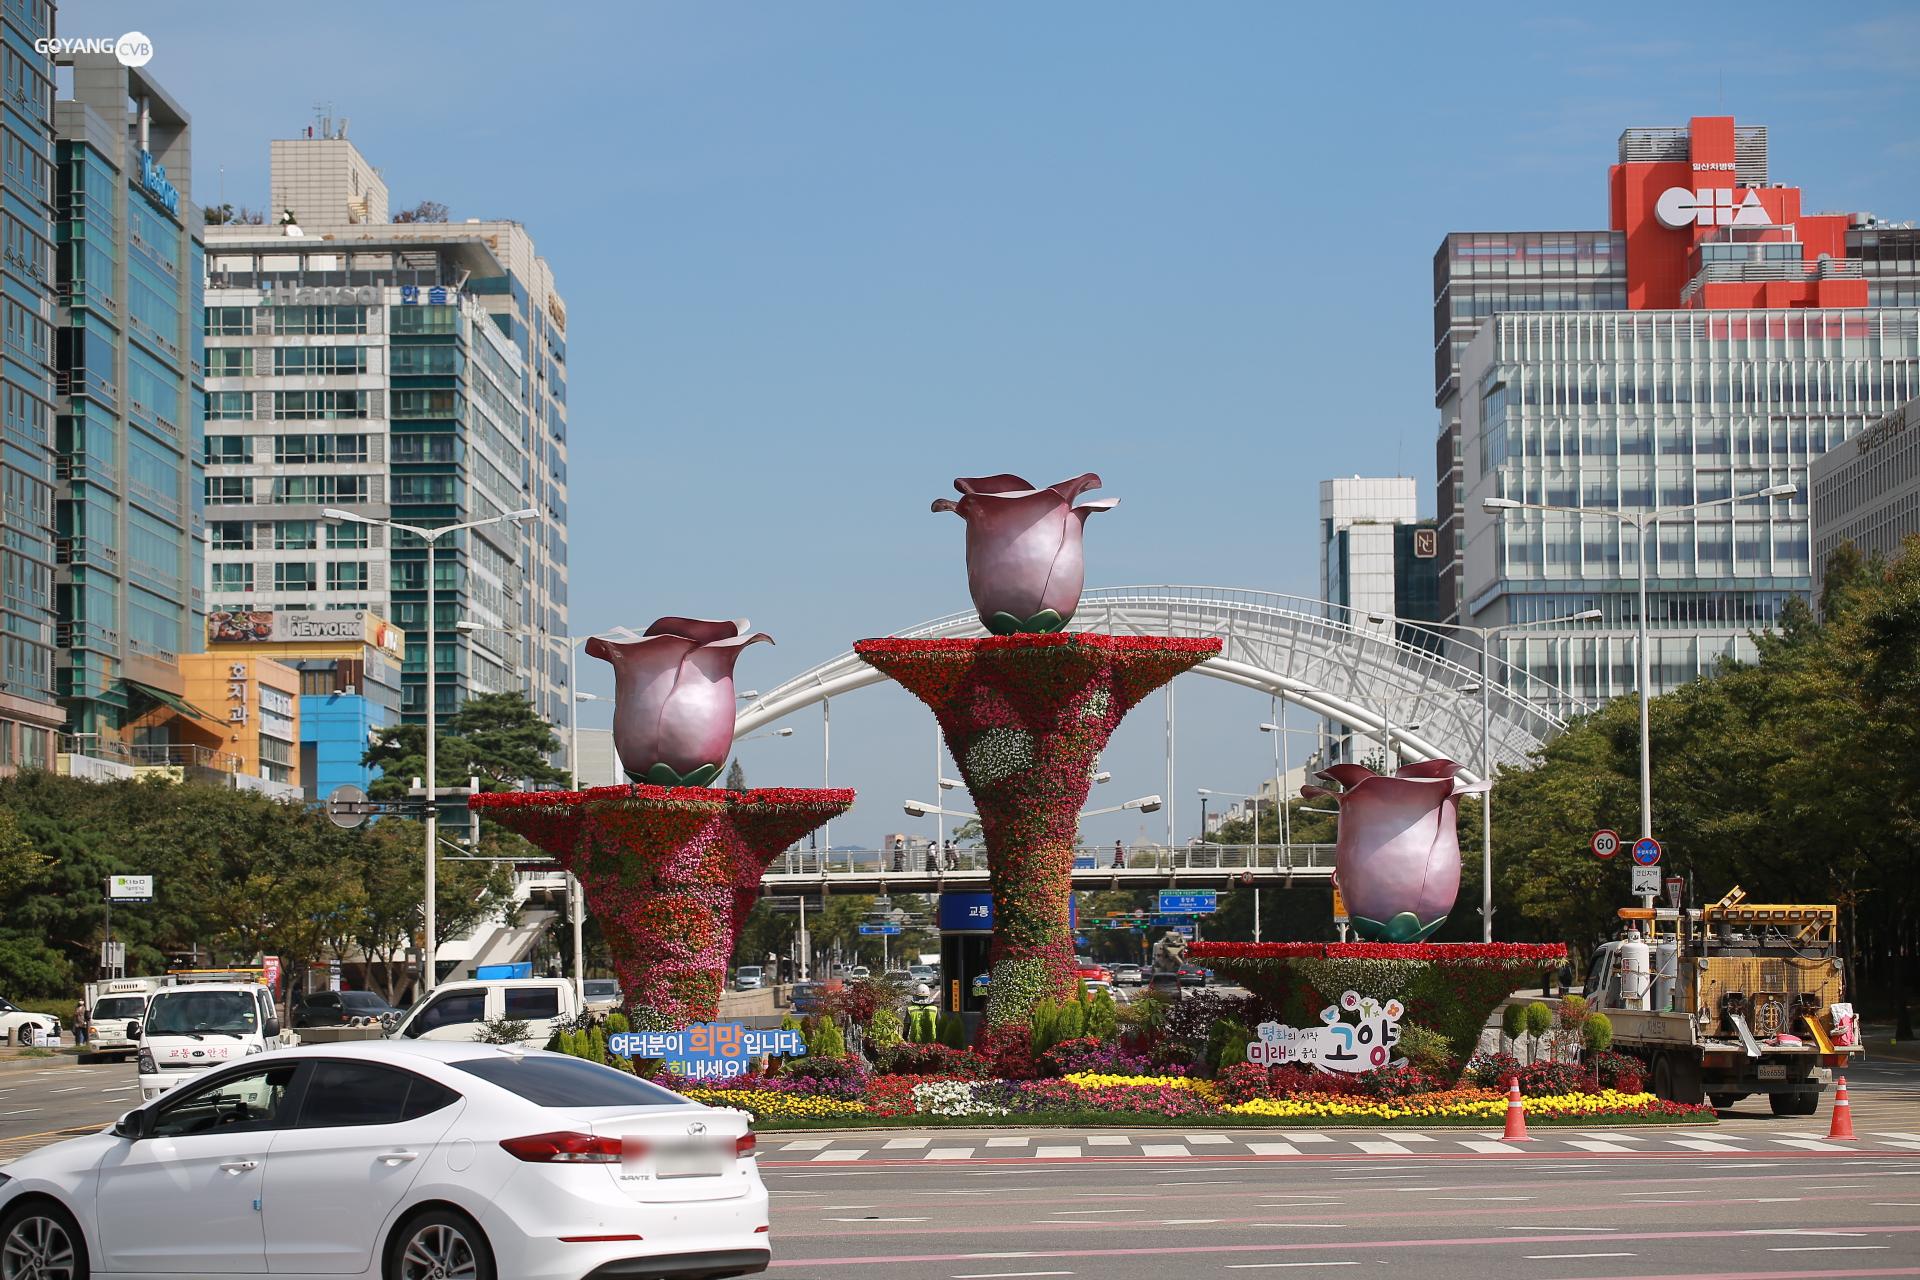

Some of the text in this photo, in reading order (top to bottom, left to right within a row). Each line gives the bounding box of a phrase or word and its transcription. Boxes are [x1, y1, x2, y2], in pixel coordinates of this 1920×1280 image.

[1692, 162, 1736, 171] 일산차병원
[275, 278, 385, 307] Hansol
[401, 285, 447, 305] 한솔
[291, 621, 361, 637] NEWYORK
[1596, 838, 1613, 850] 60
[968, 905, 989, 918] 교통
[1262, 1026, 1319, 1042] 평화의 시작
[611, 1033, 683, 1057] 여러분이
[1324, 1018, 1398, 1067] 고양
[169, 1048, 190, 1059] 교통
[207, 1047, 229, 1059] 안전
[1251, 1041, 1318, 1063] 미래의 중심
